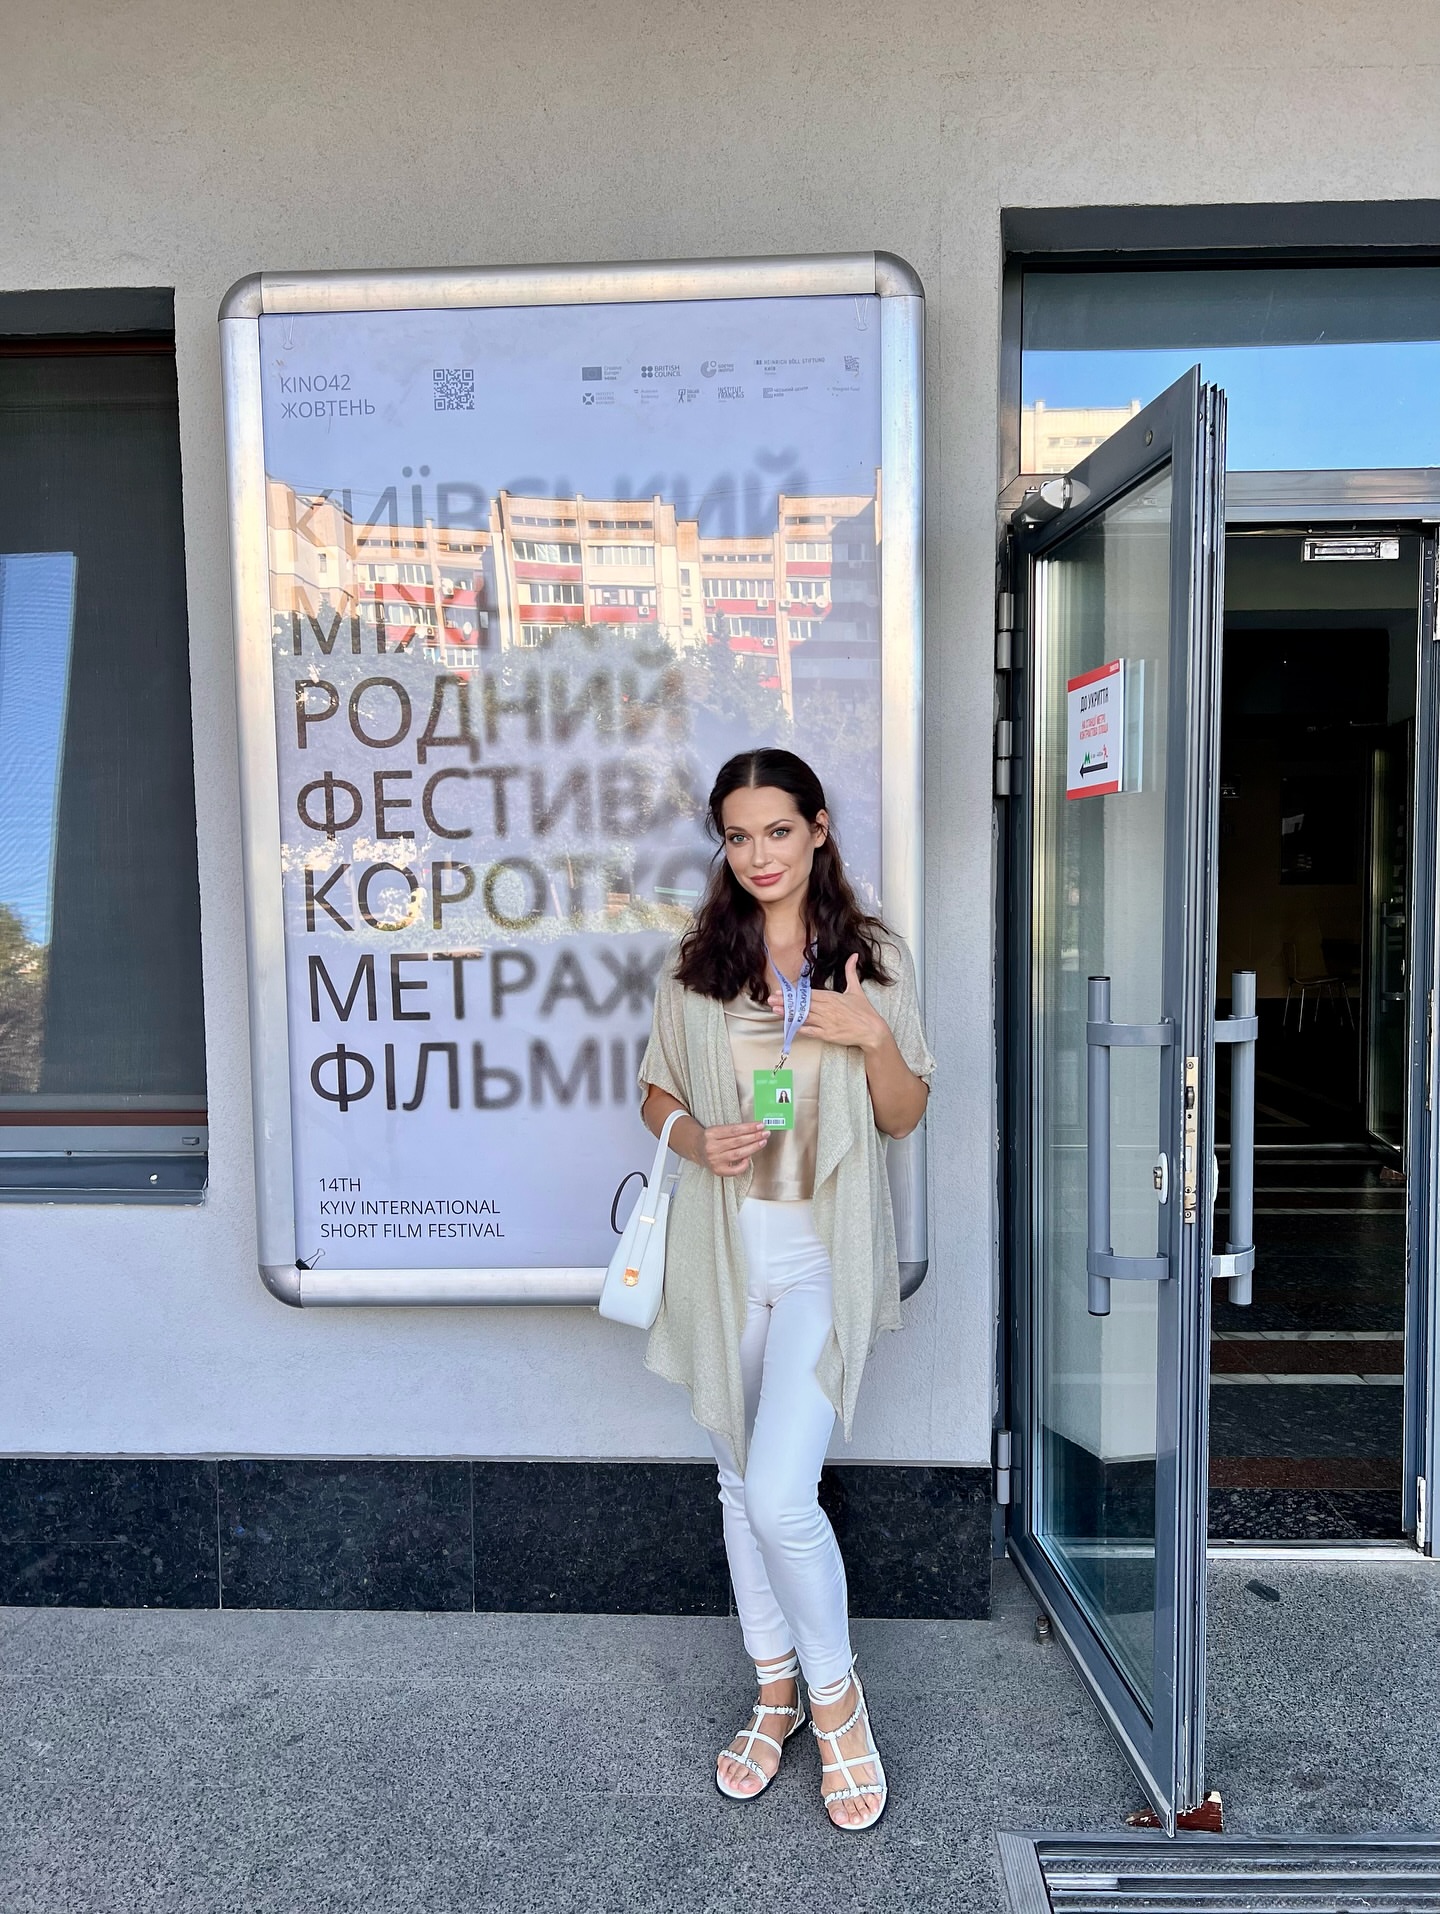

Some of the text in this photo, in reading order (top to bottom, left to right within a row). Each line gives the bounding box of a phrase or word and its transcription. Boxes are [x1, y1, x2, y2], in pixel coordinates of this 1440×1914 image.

[280, 374, 352, 393] KINO42
[717, 392, 745, 400] FRANÇAIS
[281, 399, 376, 419] ЖОВТЕНЬ
[294, 649, 691, 765] РОДНИЙ
[1080, 688, 1108, 713] ДО УКРИТТЯ
[308, 948, 662, 1023] МЕТРАЖ
[310, 1036, 648, 1113] ФІЛЬМІ
[319, 1177, 361, 1192] 14TH
[320, 1199, 501, 1215] KYIV INTERNATIONAL
[320, 1222, 505, 1239] SHORT FILM FESTIVAL
